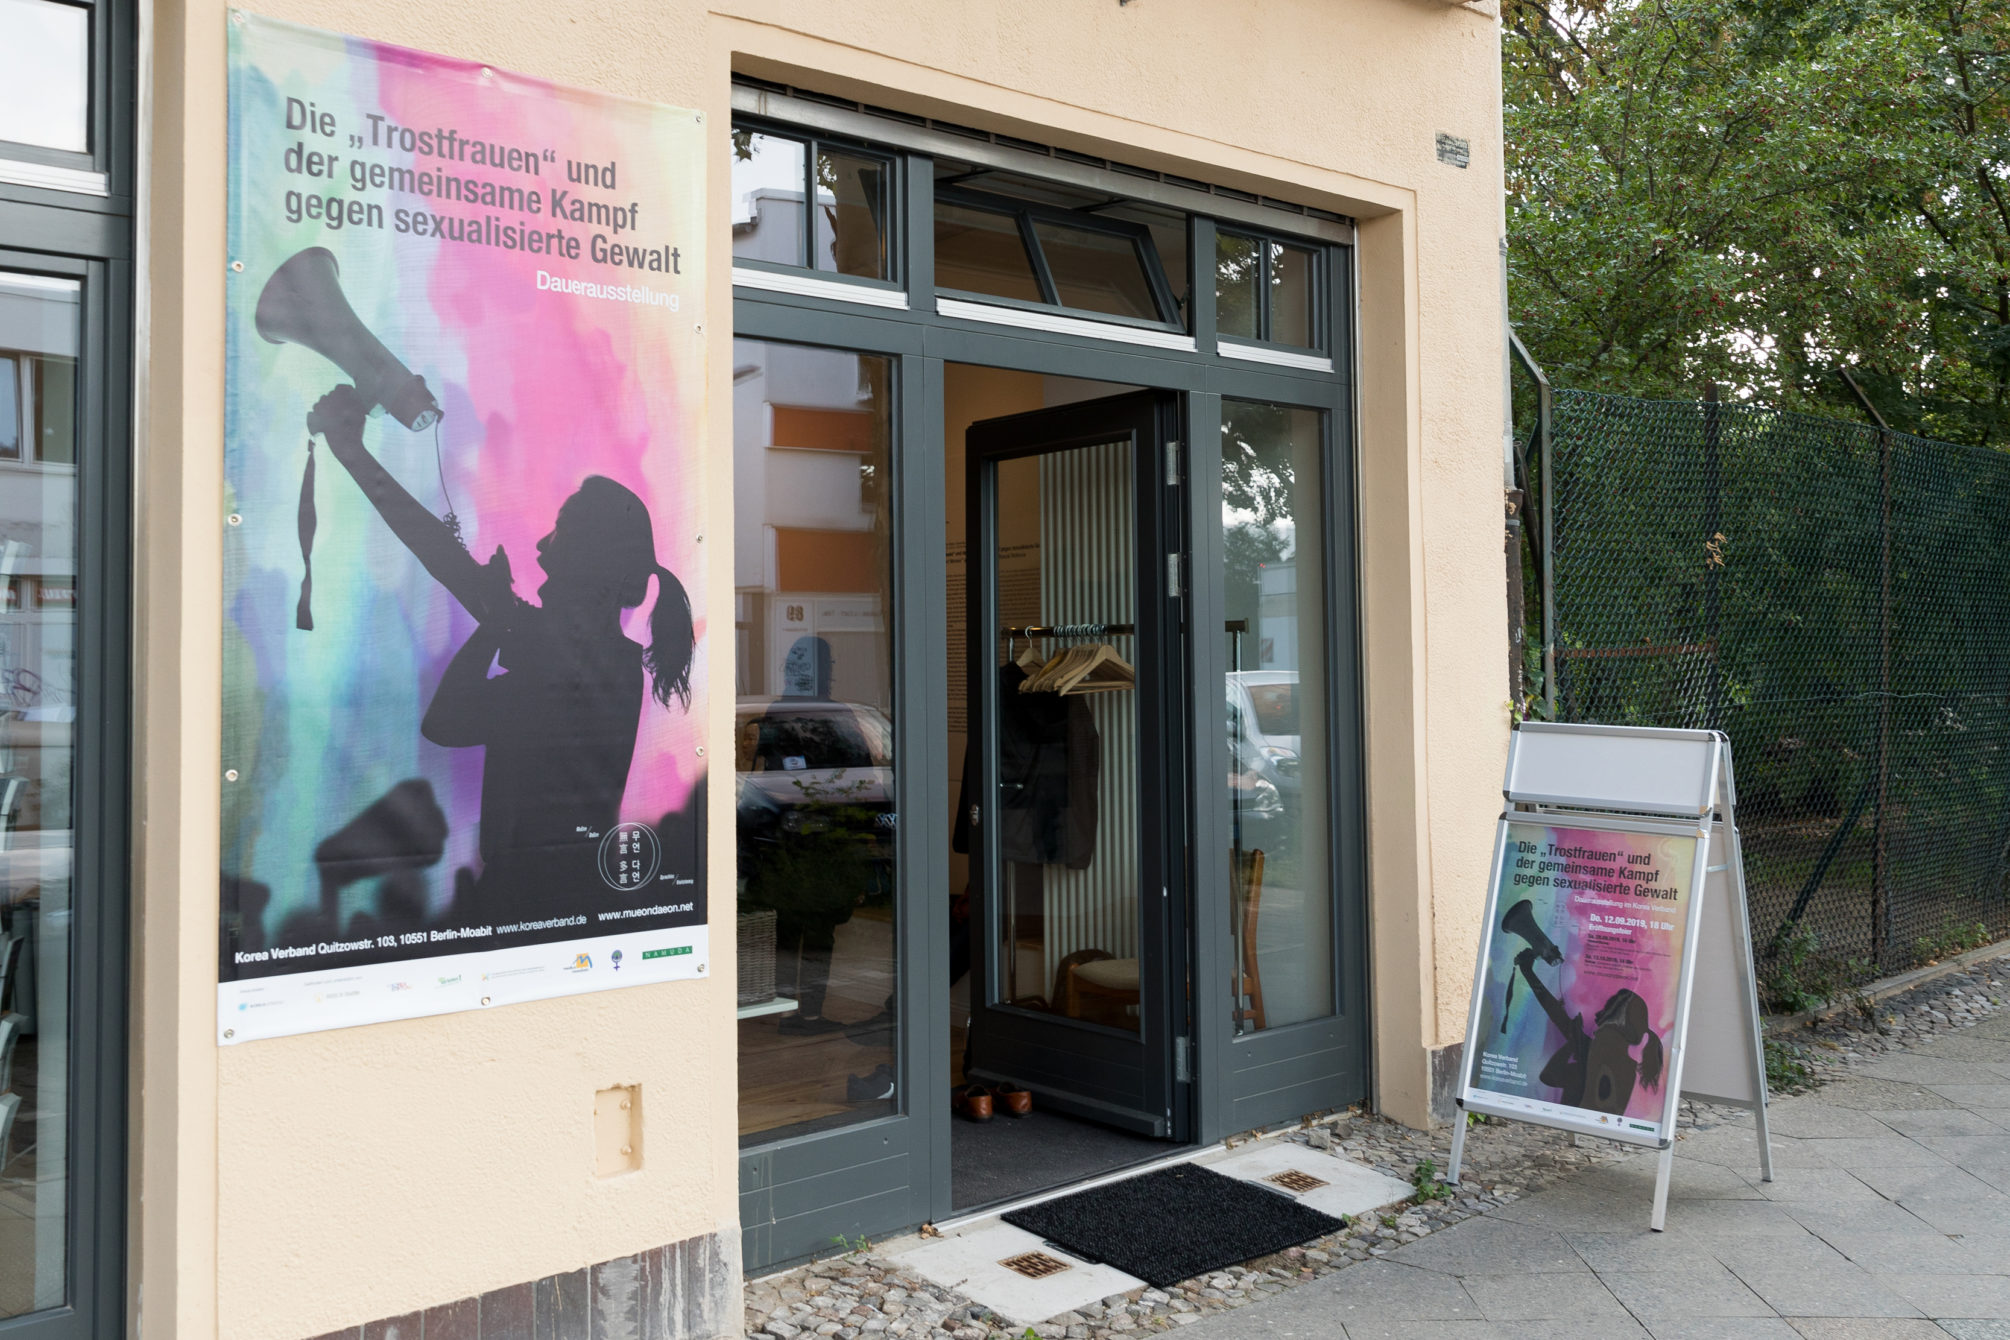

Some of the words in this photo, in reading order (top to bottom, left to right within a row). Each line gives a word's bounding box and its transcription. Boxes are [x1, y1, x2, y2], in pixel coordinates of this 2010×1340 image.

[286, 96, 336, 138] Die
[349, 113, 556, 176] „Trostfrauen“
[567, 160, 616, 190] und
[284, 141, 339, 179] der
[350, 160, 542, 215] gemeinsame
[551, 188, 638, 235] Kampf
[285, 189, 384, 231] gegen
[394, 208, 580, 260] sexualisierte
[591, 233, 681, 275] Gewalt
[536, 270, 679, 312] Dauerausstellung
[1516, 856, 1536, 869] der
[1538, 860, 1615, 878] gemeinsame
[1619, 866, 1660, 884] Kampf
[1518, 841, 1537, 854] Die
[1627, 853, 1651, 866] und
[1514, 873, 1550, 887] gegen
[1553, 877, 1630, 895] sexualisierte
[1634, 884, 1678, 901] Gewalt
[598, 902, 693, 921] www.mueondaeon.net
[235, 951, 269, 964] Korea
[271, 944, 316, 959] Verband
[318, 939, 375, 955] Quitzowstr.
[377, 935, 397, 948] 103,
[400, 931, 428, 945] 10551
[430, 925, 492, 942] Berlin-Moabit
[496, 915, 588, 935] www.koreaverband.de
